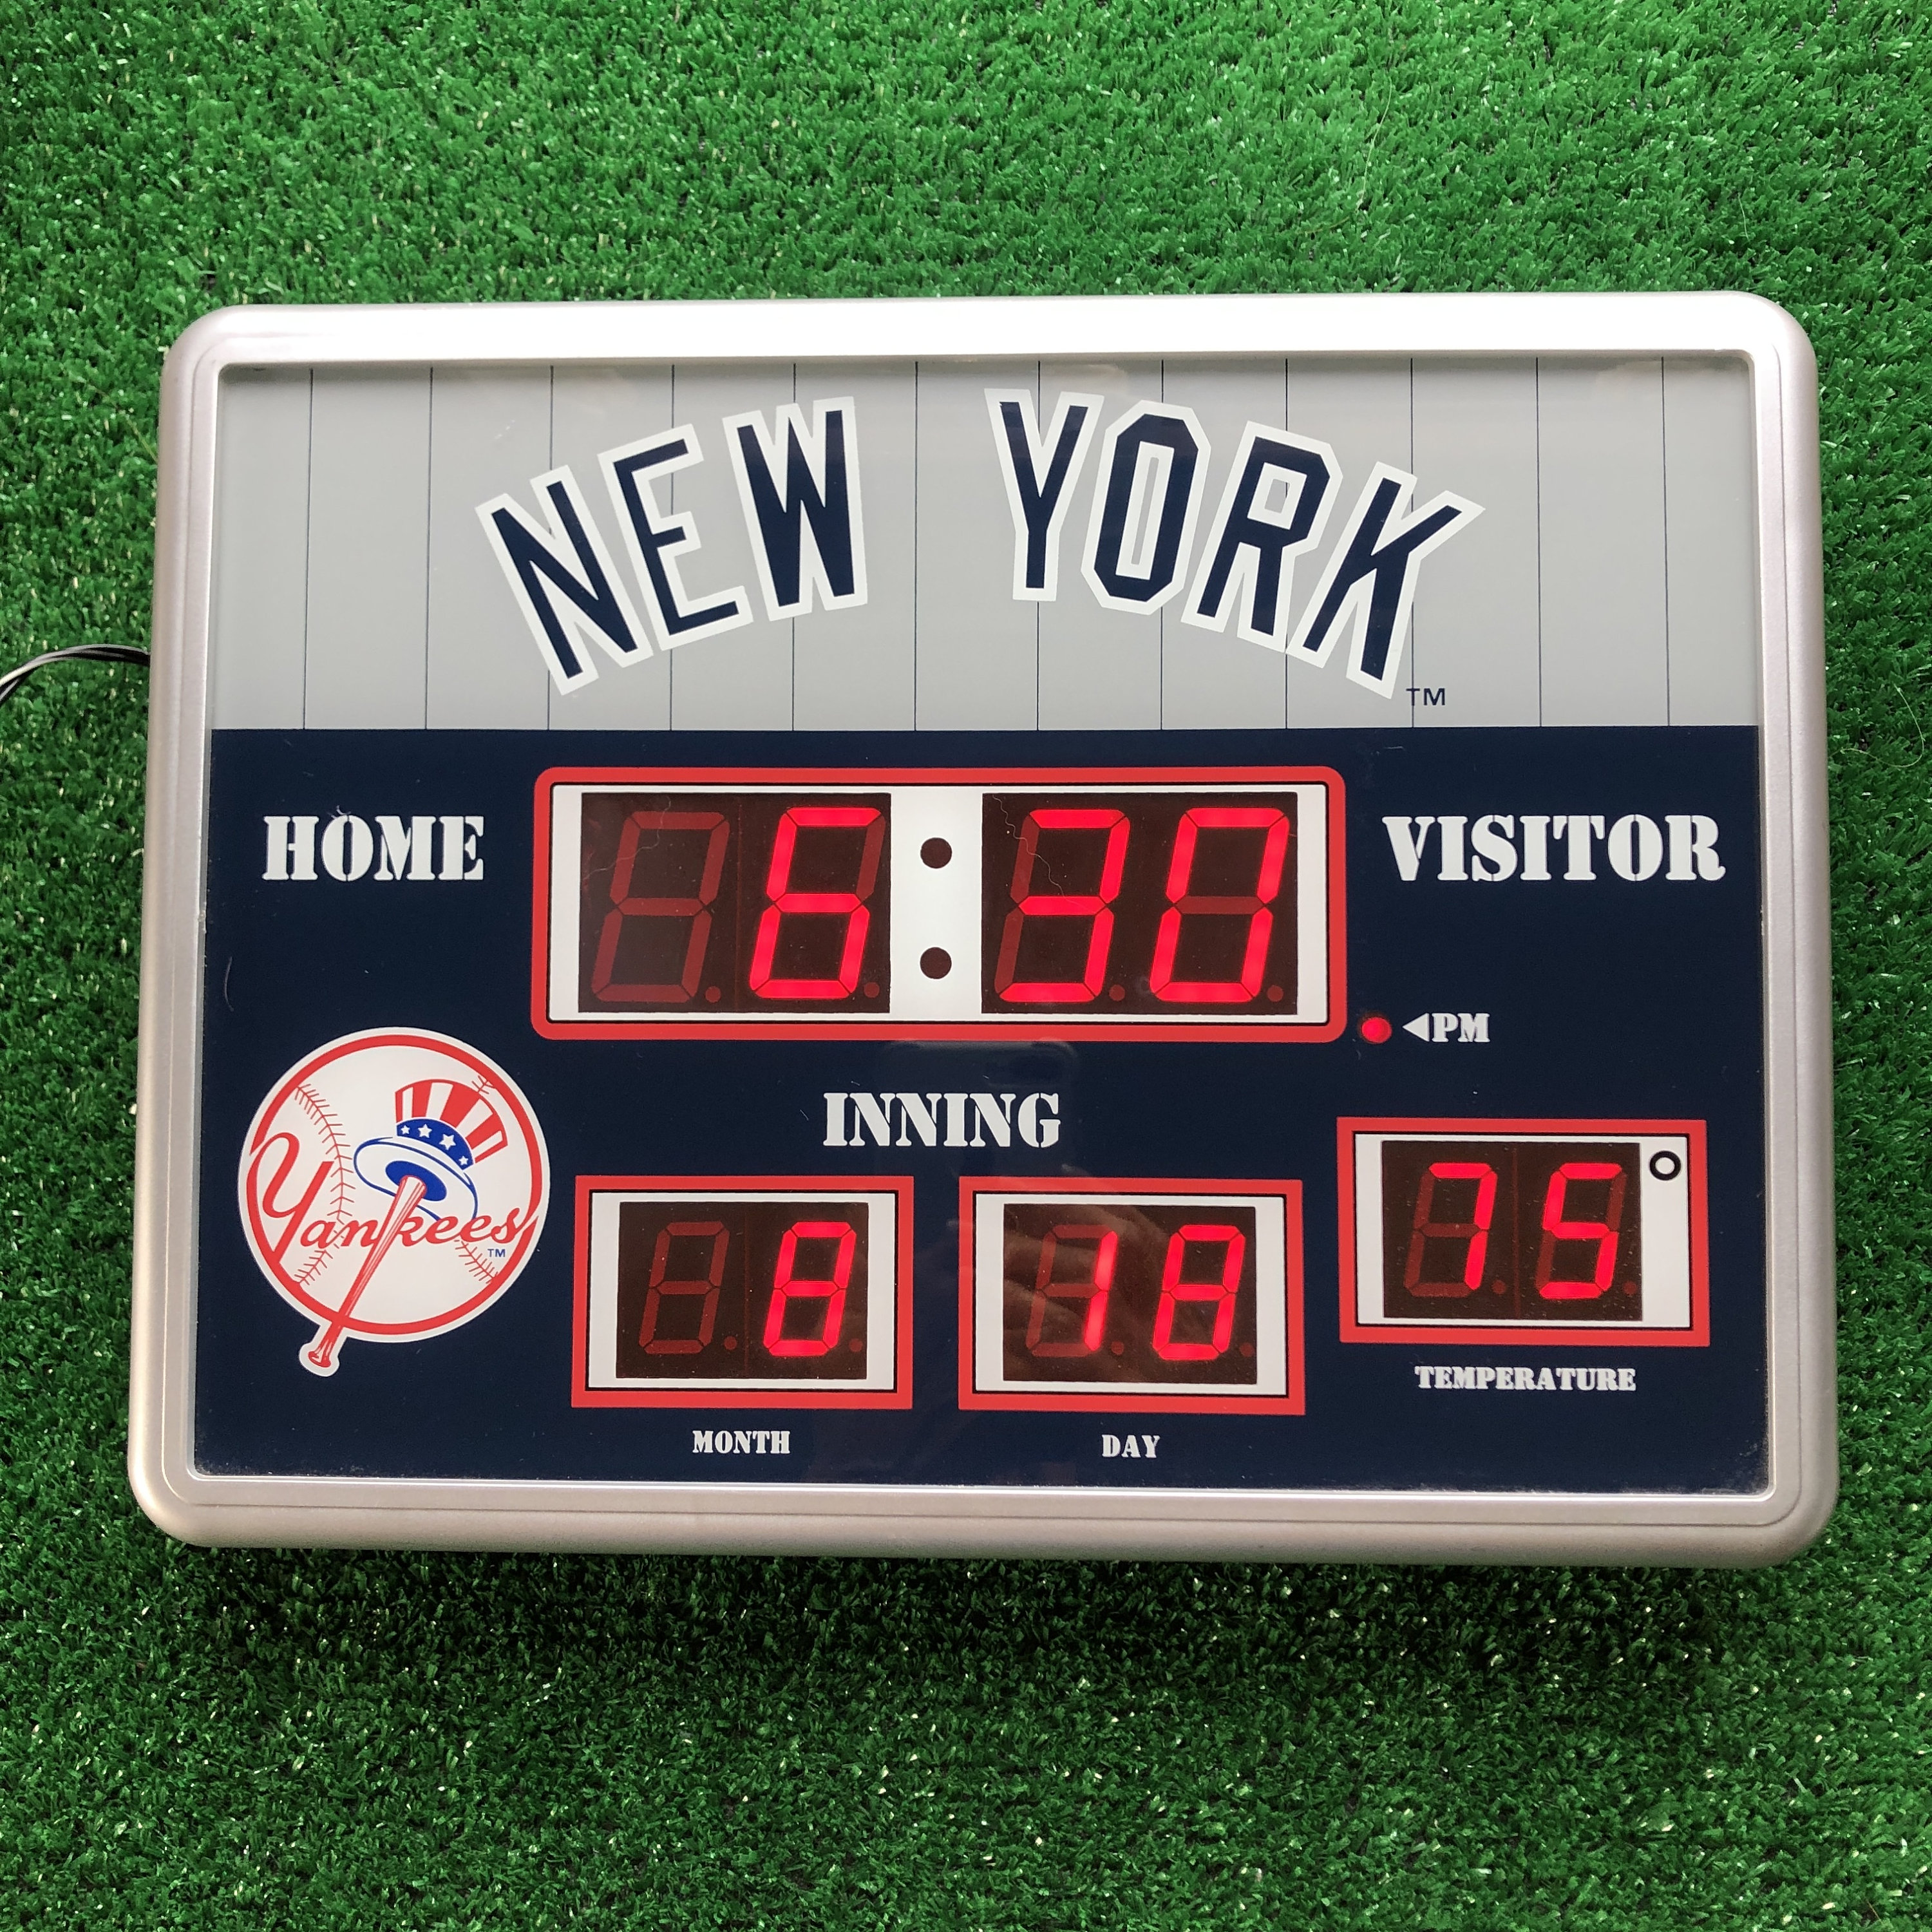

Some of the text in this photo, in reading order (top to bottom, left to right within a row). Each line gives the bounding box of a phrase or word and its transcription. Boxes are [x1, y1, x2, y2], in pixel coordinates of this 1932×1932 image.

[475, 388, 1486, 706] NEW YORK TM
[261, 815, 484, 882] HOME
[1381, 813, 1727, 881] VISITOR
[1432, 1013, 1490, 1043] PM
[822, 1092, 1061, 1148] INNING
[246, 1132, 527, 1264] Yankees
[488, 1249, 506, 1258] TM
[762, 1221, 857, 1357] 8
[1084, 1224, 1247, 1361] 18
[1414, 1365, 1637, 1392] TEMPERATURE
[692, 1430, 790, 1455] MONTH
[1101, 1434, 1160, 1459] DAY
